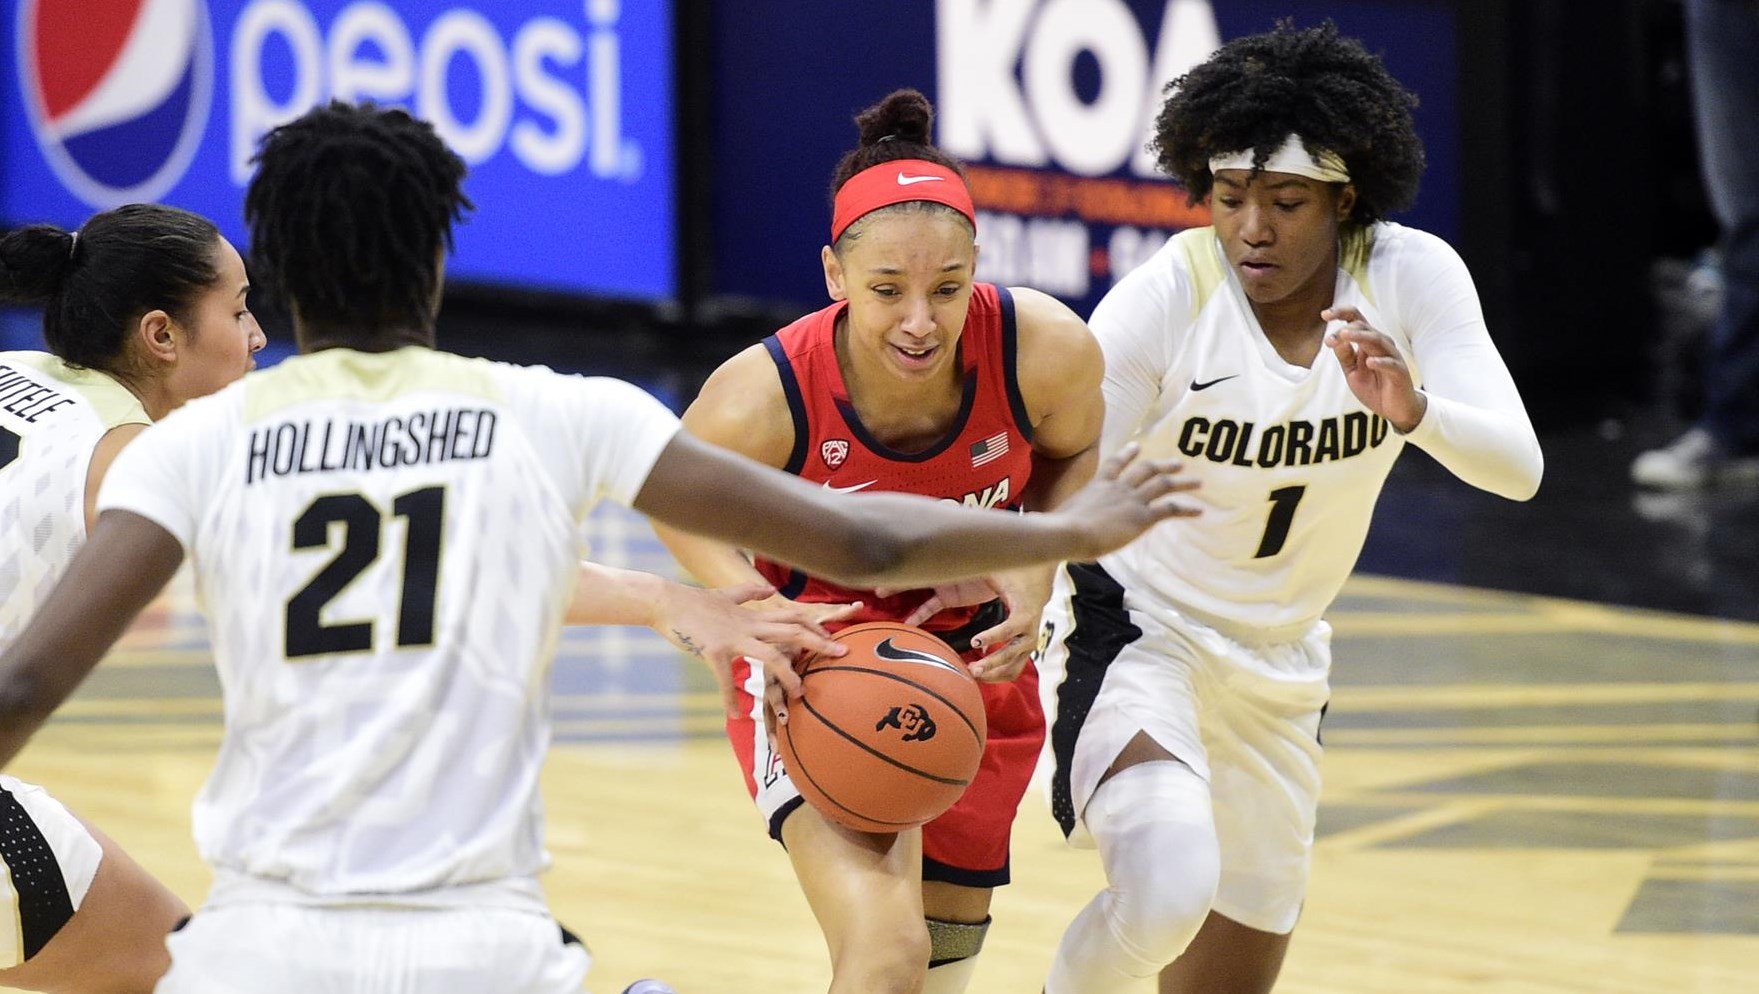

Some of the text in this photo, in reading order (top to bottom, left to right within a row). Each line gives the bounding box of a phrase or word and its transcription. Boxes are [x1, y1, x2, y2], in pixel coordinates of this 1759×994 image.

[246, 409, 498, 485] HOLLINGSHED
[822, 440, 849, 460] PAC
[1177, 410, 1389, 469] COLORADO
[1253, 484, 1307, 559] 1
[285, 484, 447, 659] 21
